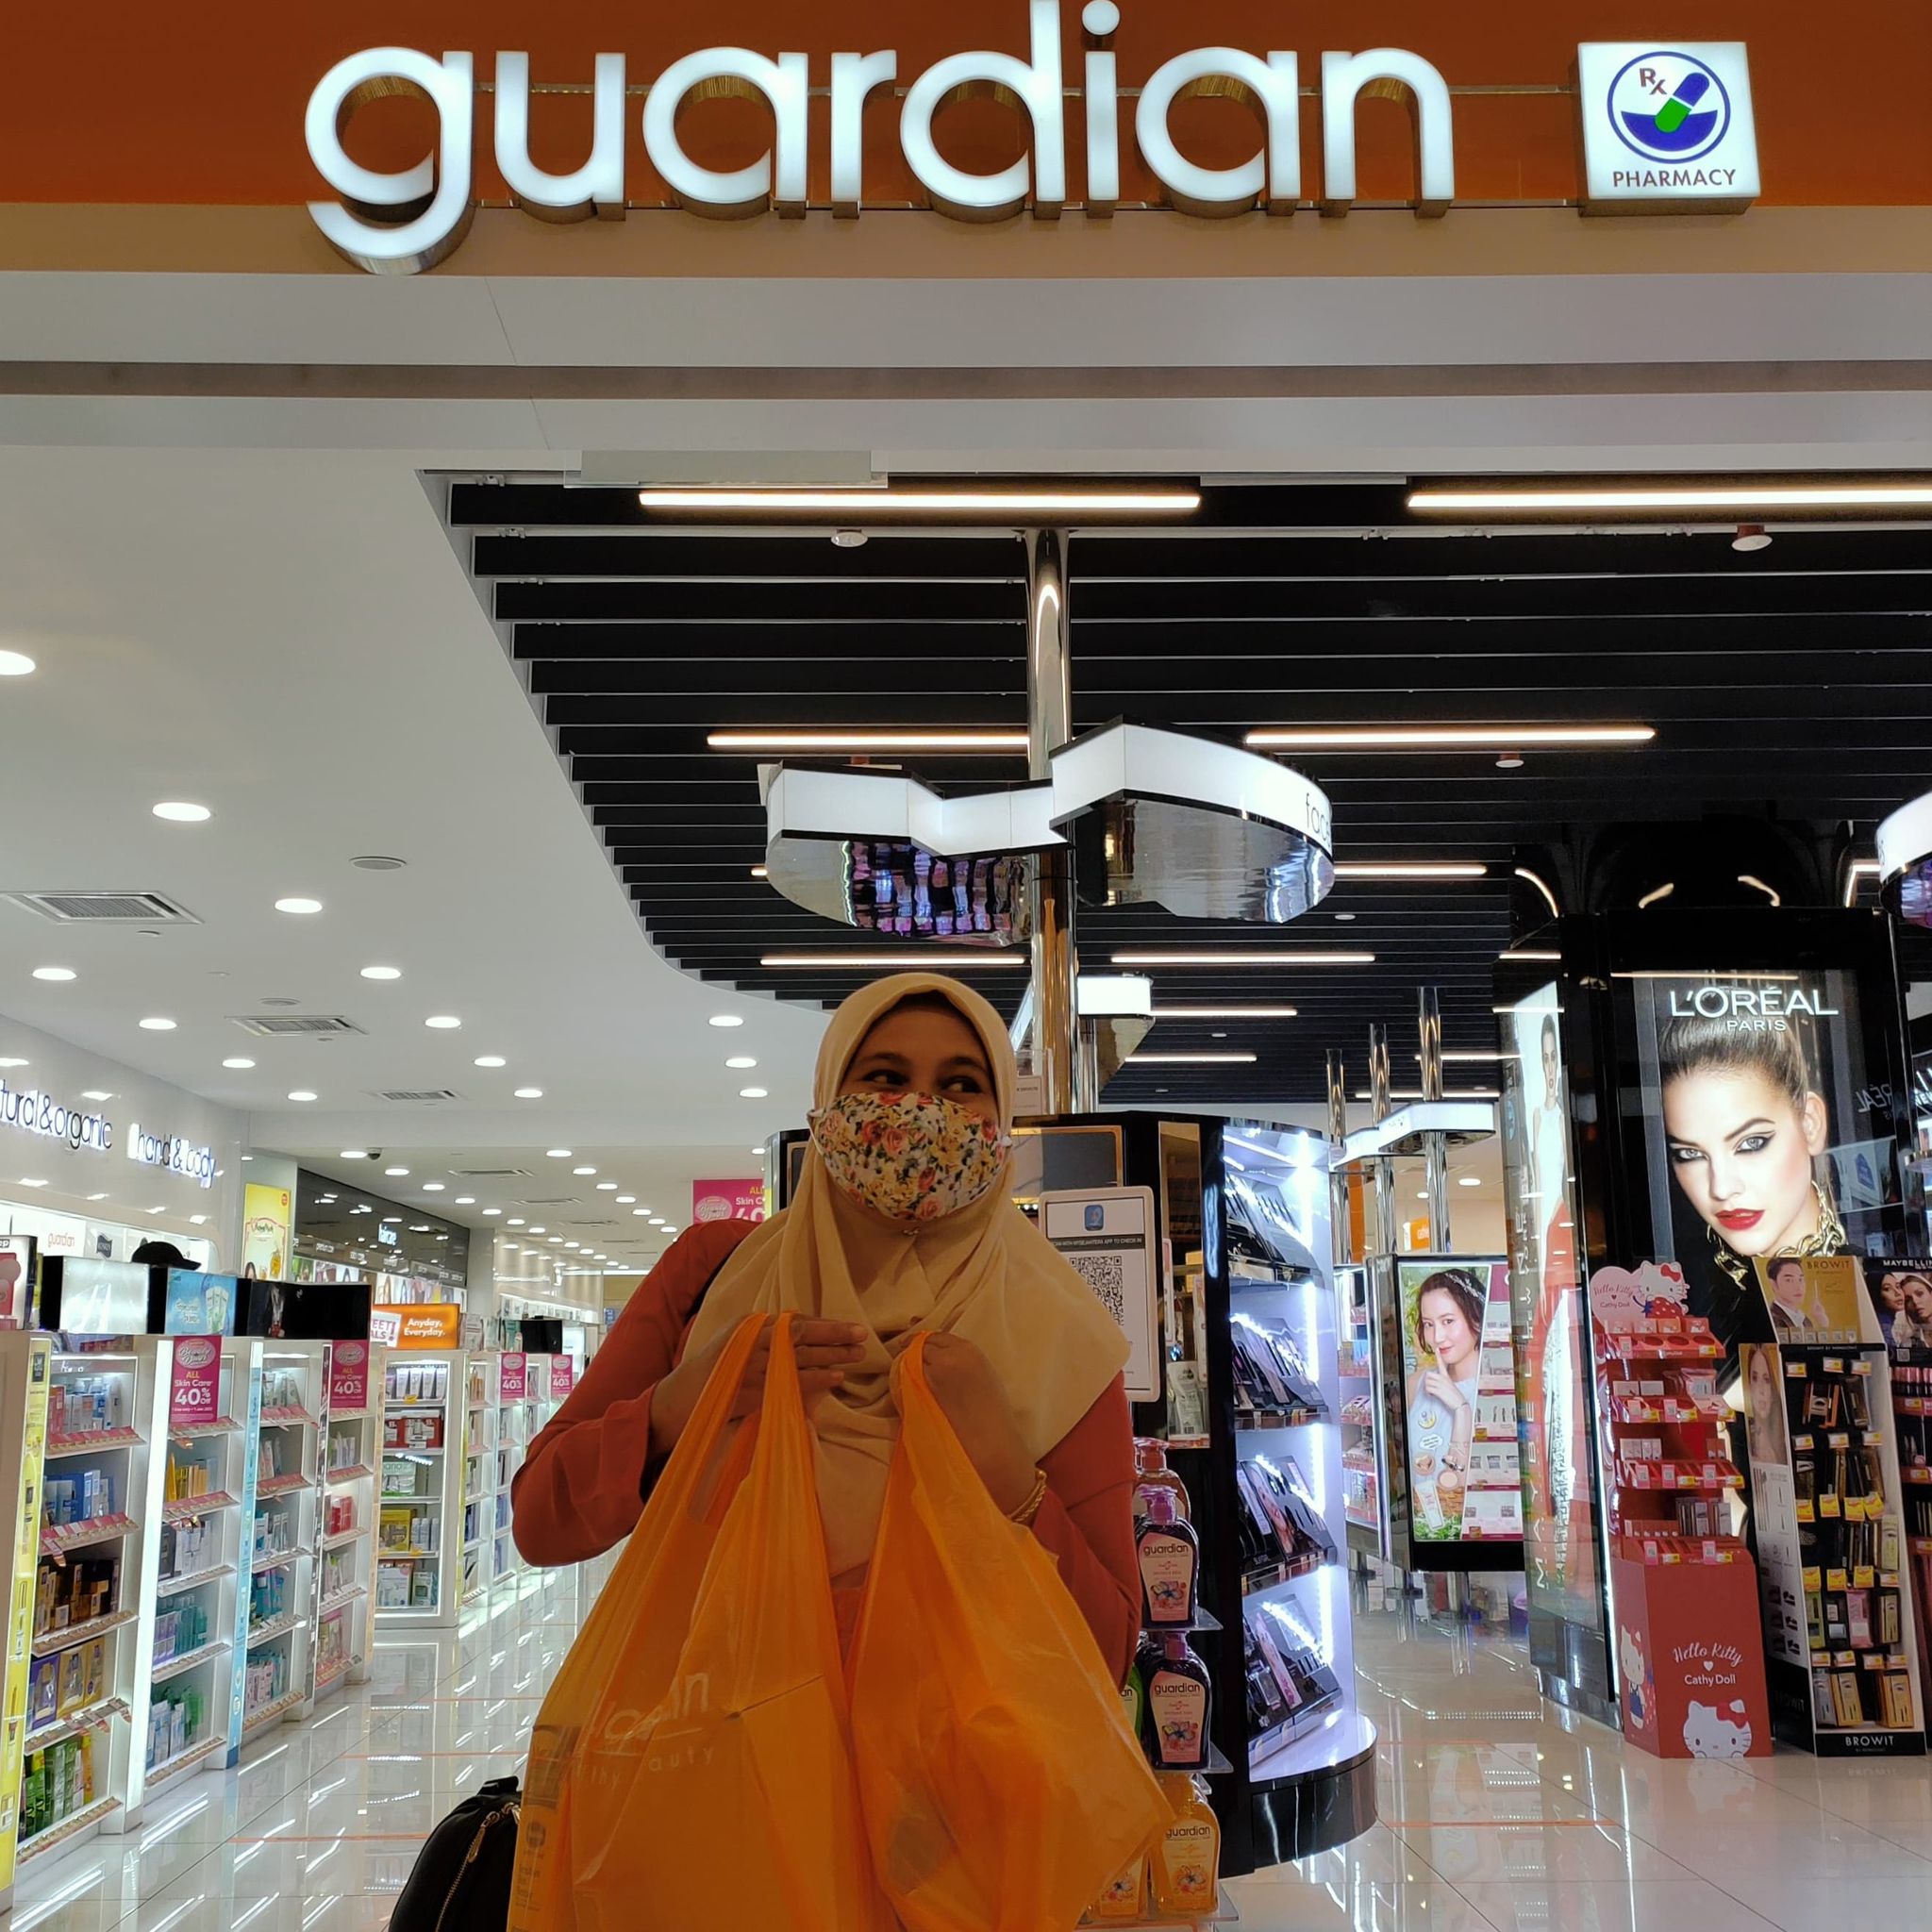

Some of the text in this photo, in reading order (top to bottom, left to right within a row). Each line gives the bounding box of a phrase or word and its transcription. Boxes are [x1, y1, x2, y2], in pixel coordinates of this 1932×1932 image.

[305, 0, 1455, 259] guardian
[1612, 169, 1736, 188] PHARMACY
[1727, 1020, 1787, 1032] PARIS
[54, 1107, 113, 1150] organic
[138, 1124, 173, 1166] hand
[736, 1197, 754, 1206] Skin
[1807, 1260, 1851, 1270] BROWIT
[408, 1318, 442, 1328] Anyday.
[404, 1327, 445, 1337] Everyday.
[186, 1371, 200, 1379] ALL
[174, 1379, 191, 1388] Skin
[1143, 1542, 1189, 1557] guardian
[1674, 1641, 1743, 1667] Hello Kitty
[1684, 1674, 1737, 1688] Cathy Doll
[1154, 1682, 1201, 1695] guardian
[1844, 1735, 1895, 1747] BROWIT
[1165, 1825, 1211, 1840] guardian
